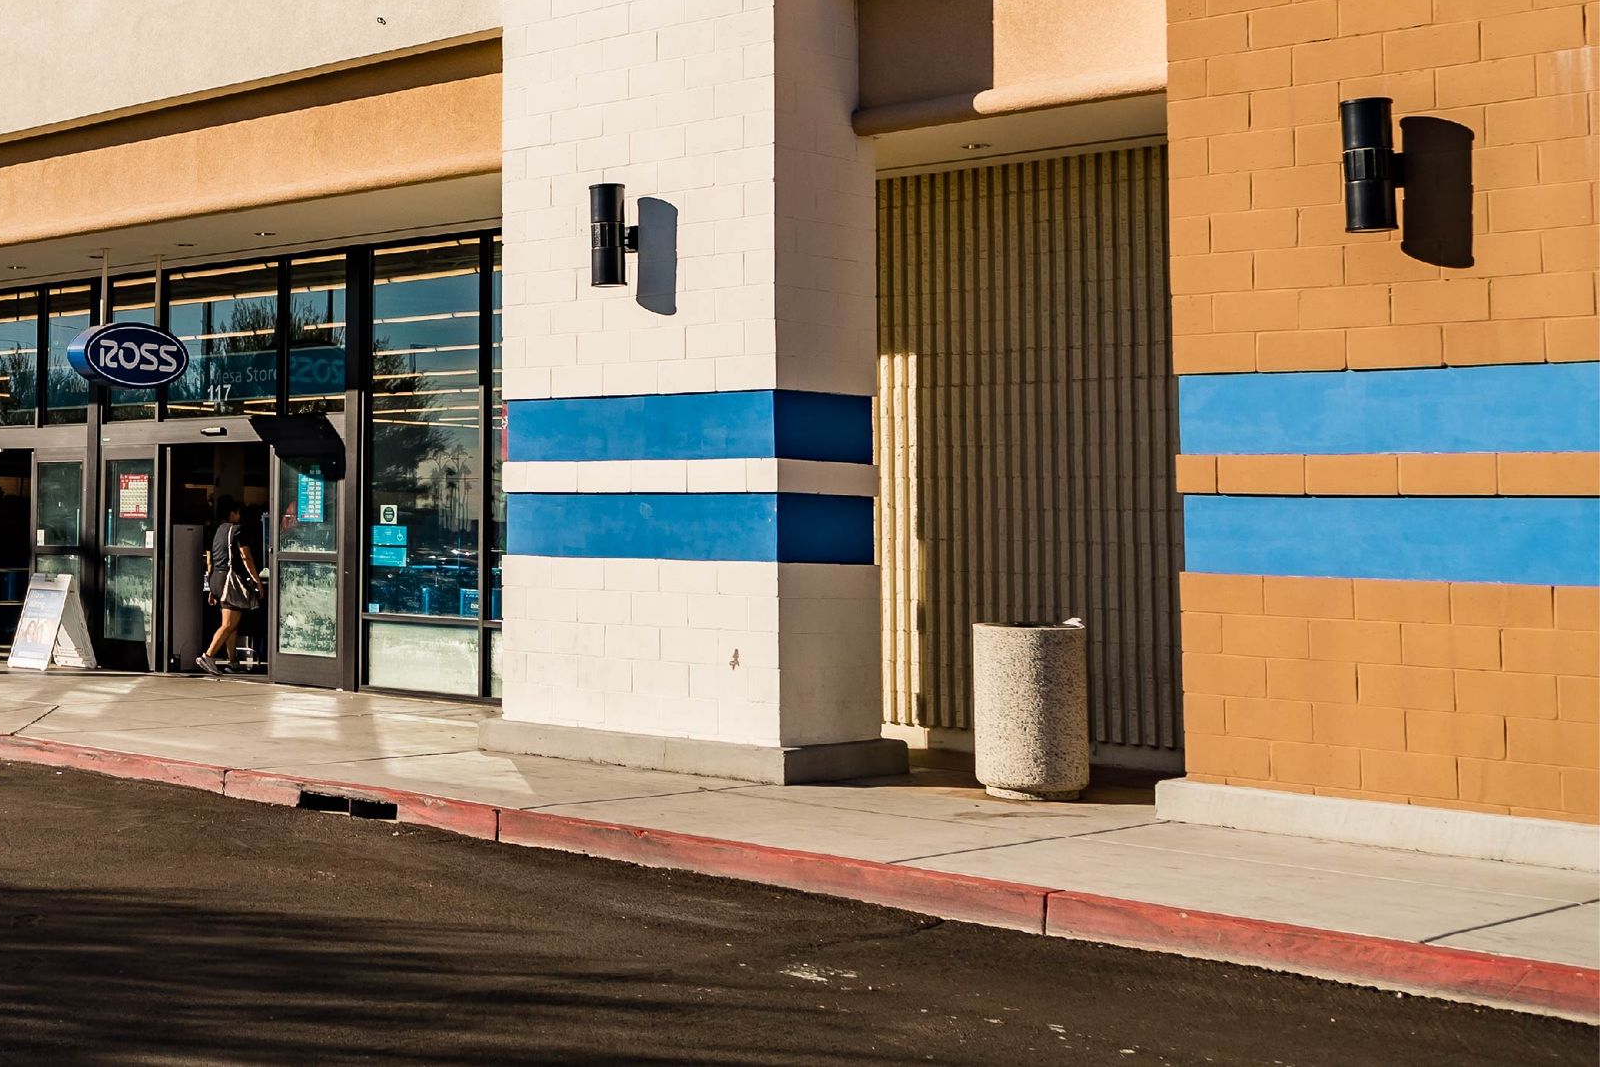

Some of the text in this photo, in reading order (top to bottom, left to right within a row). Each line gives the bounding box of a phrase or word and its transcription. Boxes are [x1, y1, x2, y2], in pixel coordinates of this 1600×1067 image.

[100, 339, 177, 373] ROSS
[209, 368, 242, 384] Mesa
[207, 384, 232, 402] 117
